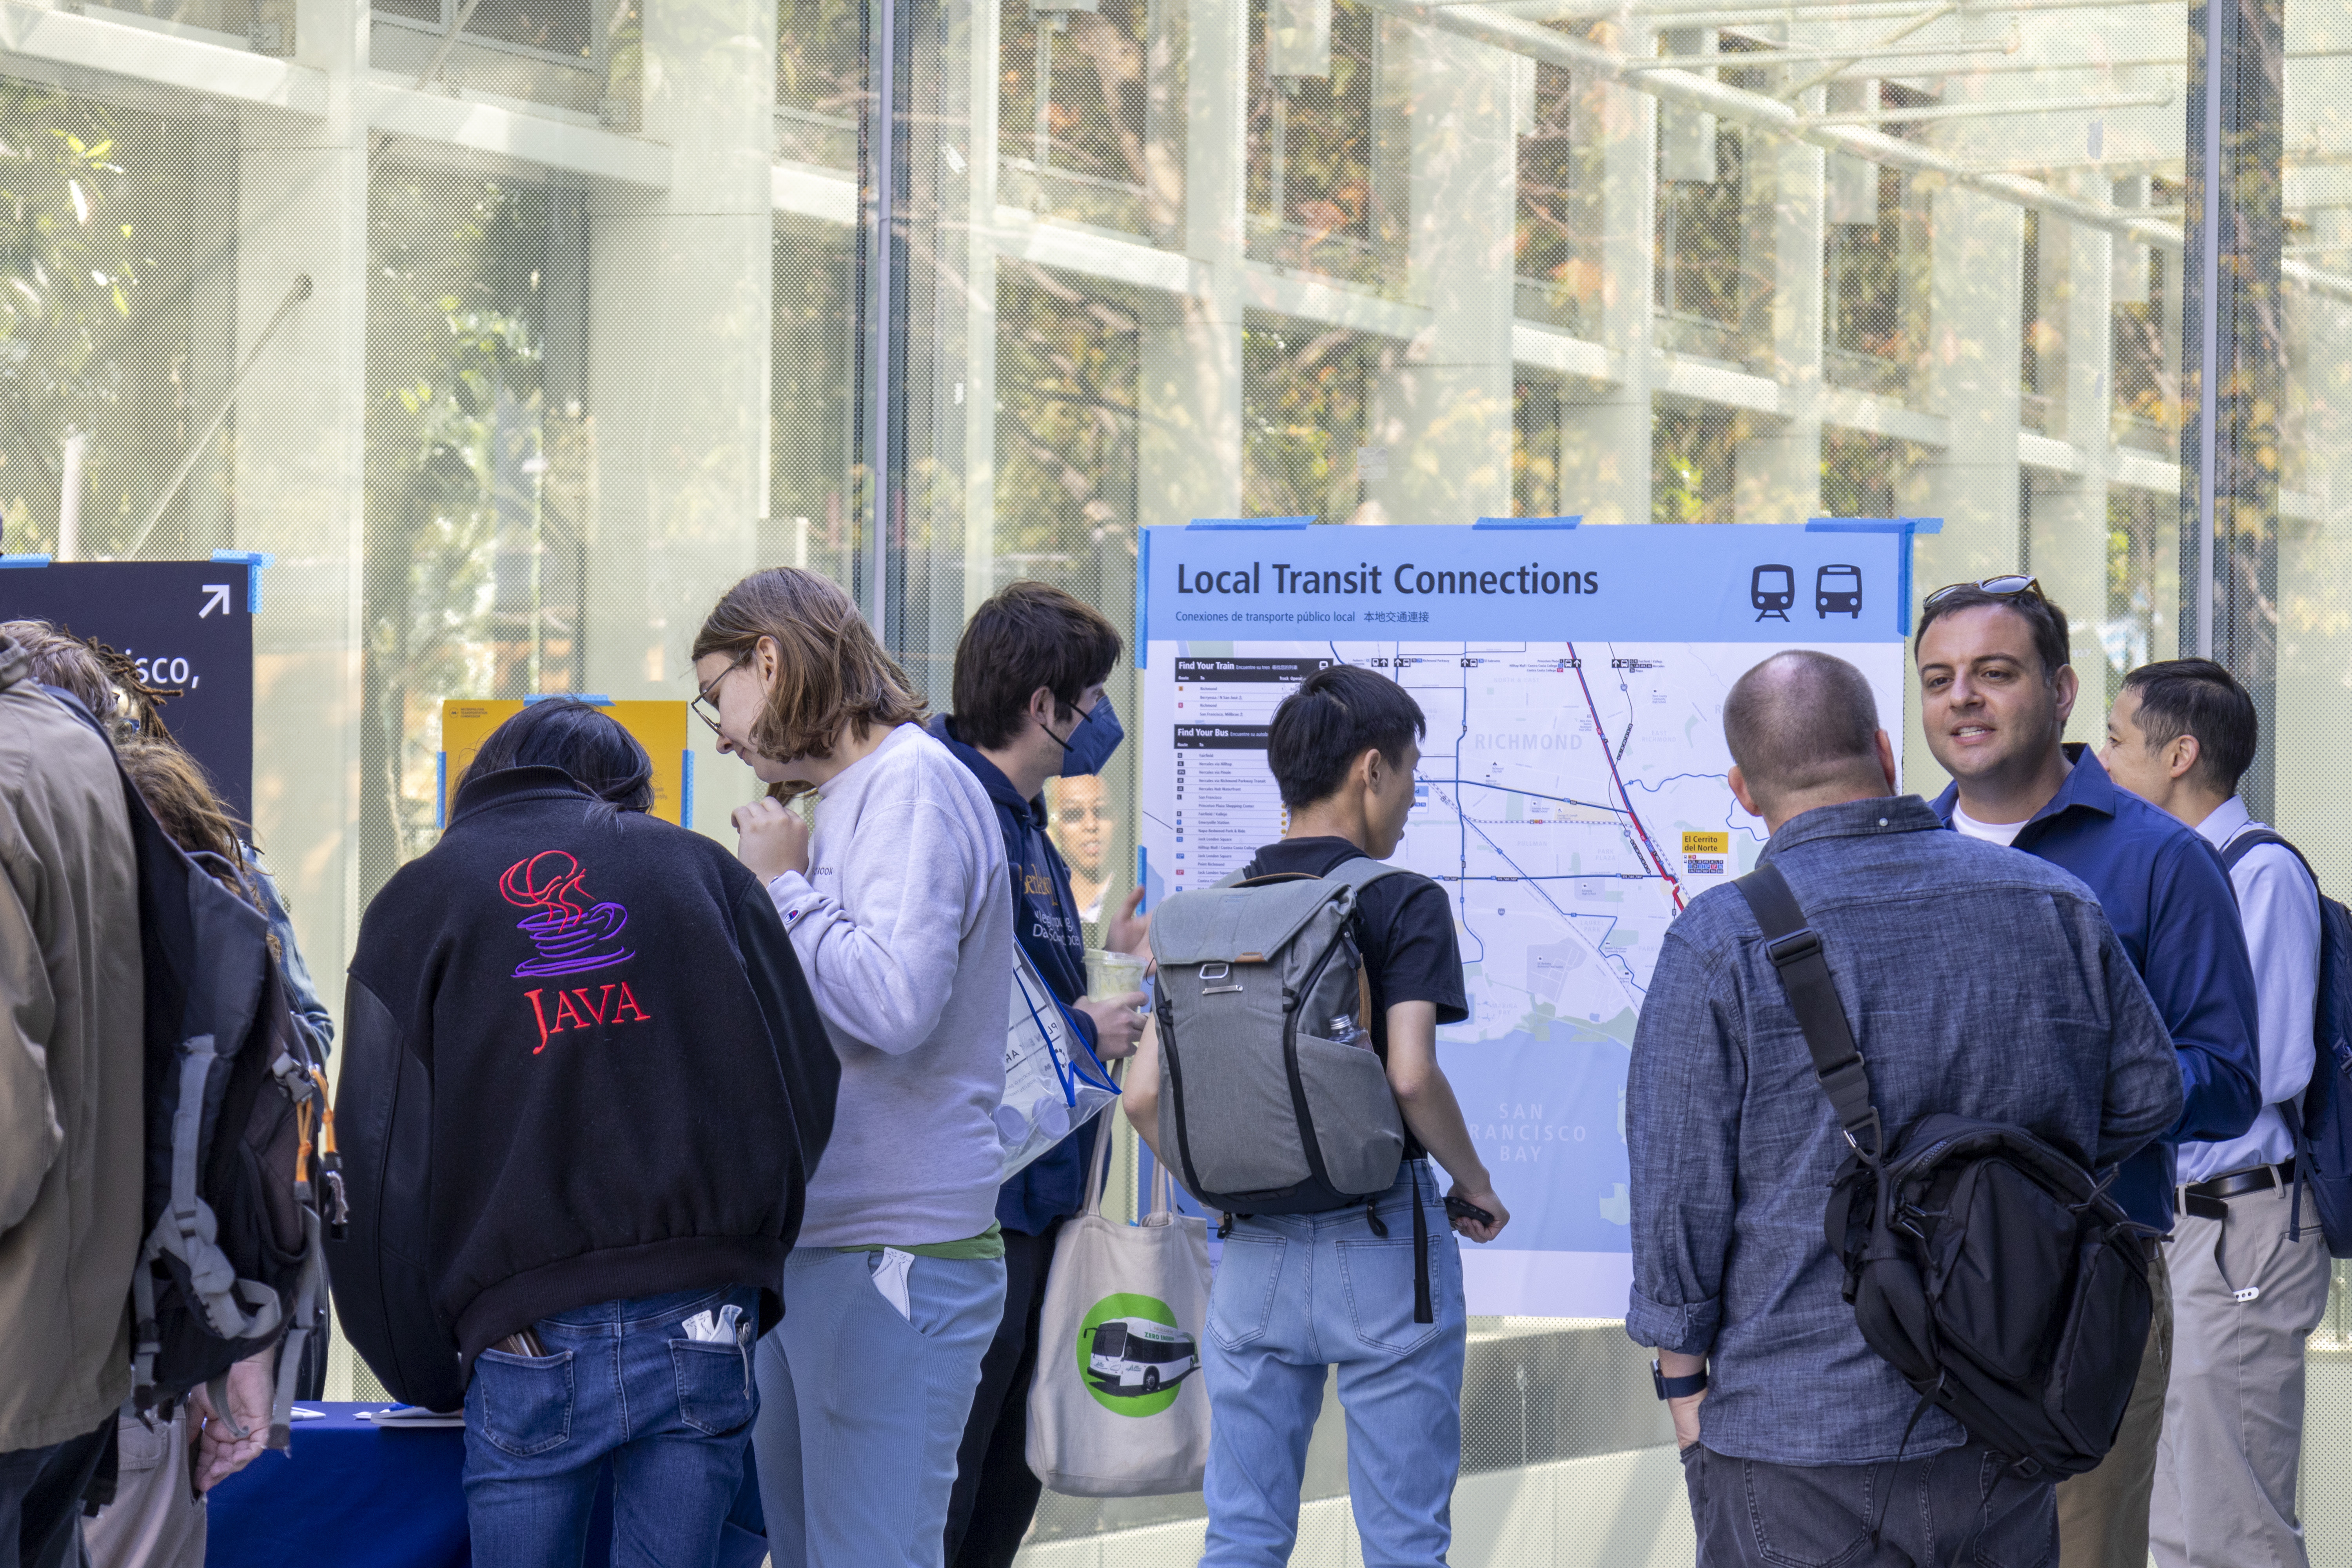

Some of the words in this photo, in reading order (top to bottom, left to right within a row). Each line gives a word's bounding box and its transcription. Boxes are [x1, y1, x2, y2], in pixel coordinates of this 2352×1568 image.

[1178, 561, 1259, 593] Local
[1272, 562, 1382, 593] Transit
[1394, 562, 1598, 594] Connections
[1176, 611, 1228, 621] Conexiones
[1232, 612, 1242, 621] de
[1246, 612, 1294, 623] transporte
[1297, 611, 1330, 623] público
[1334, 612, 1355, 621] local
[1363, 611, 1429, 622] 本地交通連接
[1178, 661, 1195, 670] Find
[1216, 661, 1234, 670] Train
[1178, 728, 1194, 736] Find
[1475, 734, 1583, 750] RICHMOND
[524, 982, 651, 1054] JAVA
[1499, 1103, 1543, 1120] SAN
[1469, 1124, 1586, 1142] RANCISCO
[1500, 1145, 1542, 1163] BAY
